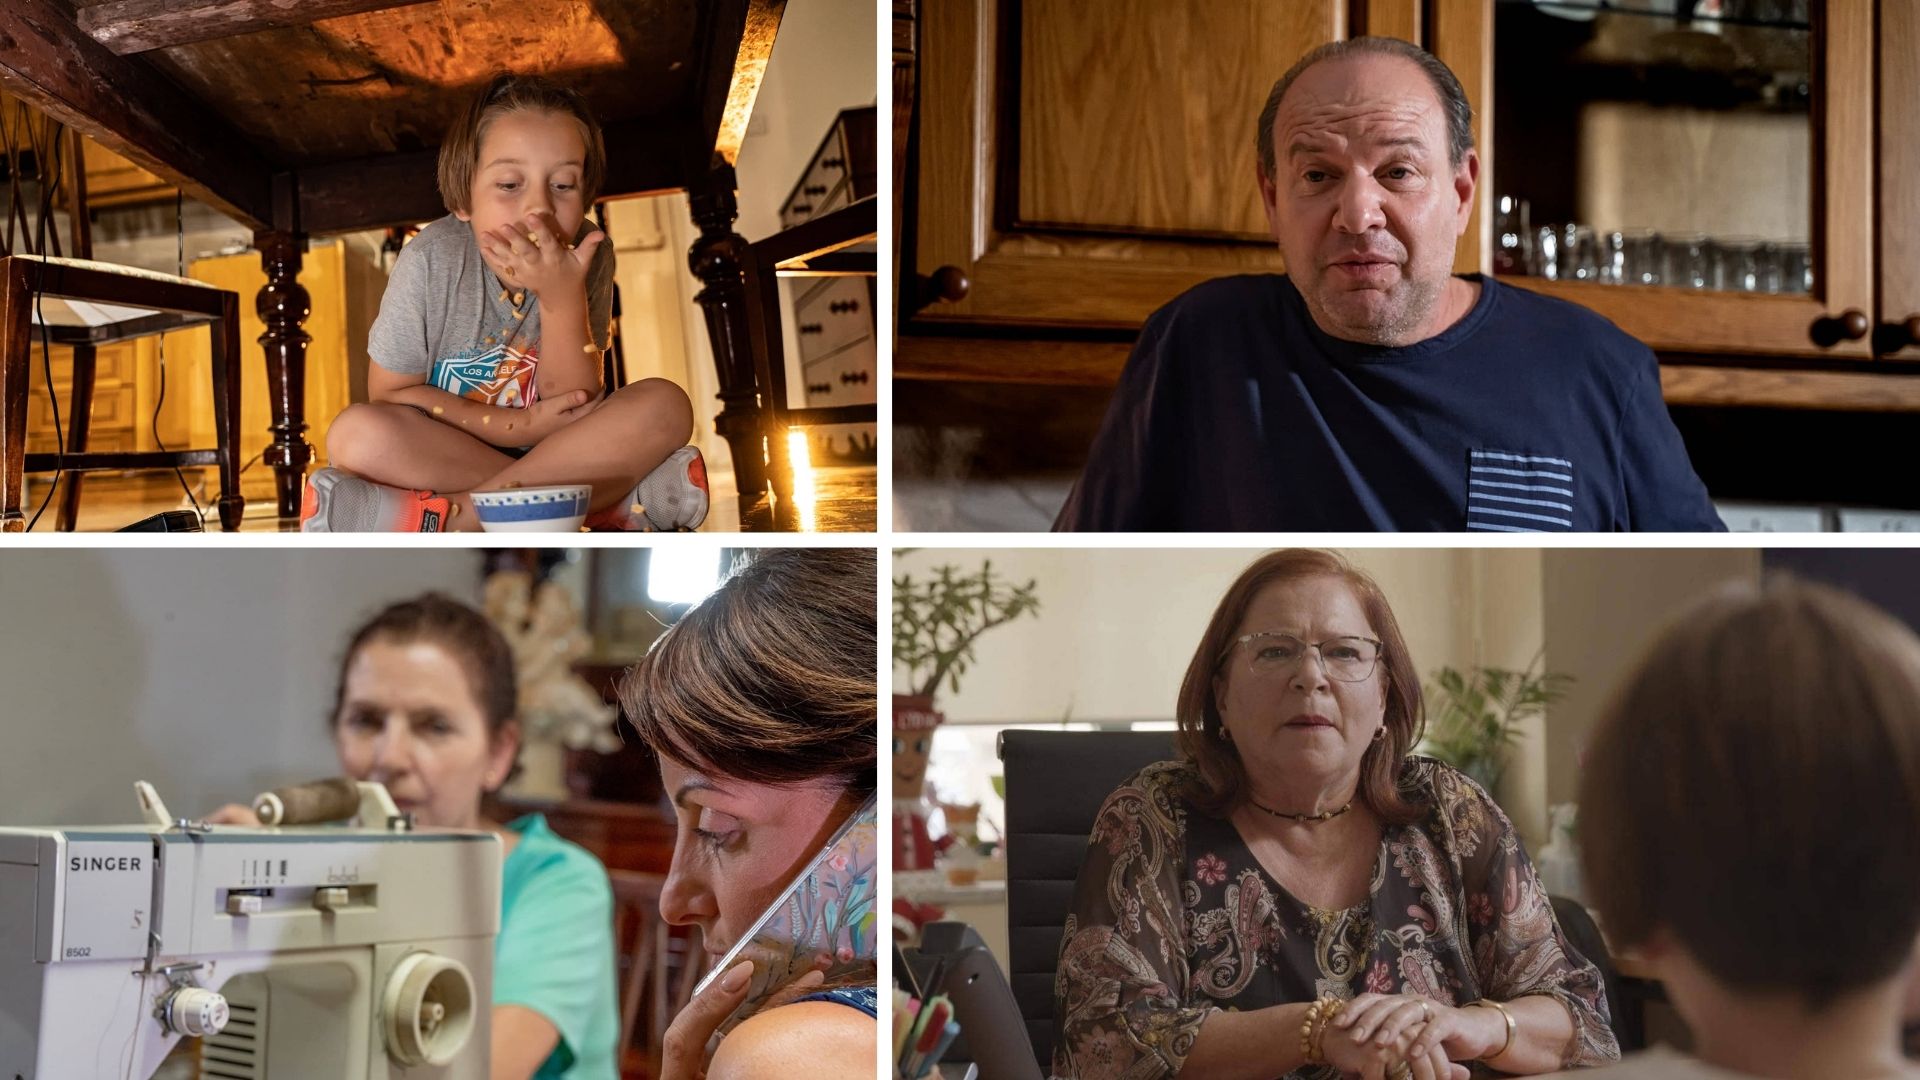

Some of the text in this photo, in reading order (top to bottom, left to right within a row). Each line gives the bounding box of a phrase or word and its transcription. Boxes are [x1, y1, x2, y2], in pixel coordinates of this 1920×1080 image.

[463, 367, 482, 376] LOS
[71, 857, 141, 871] SINGER
[66, 947, 91, 957] 8502
